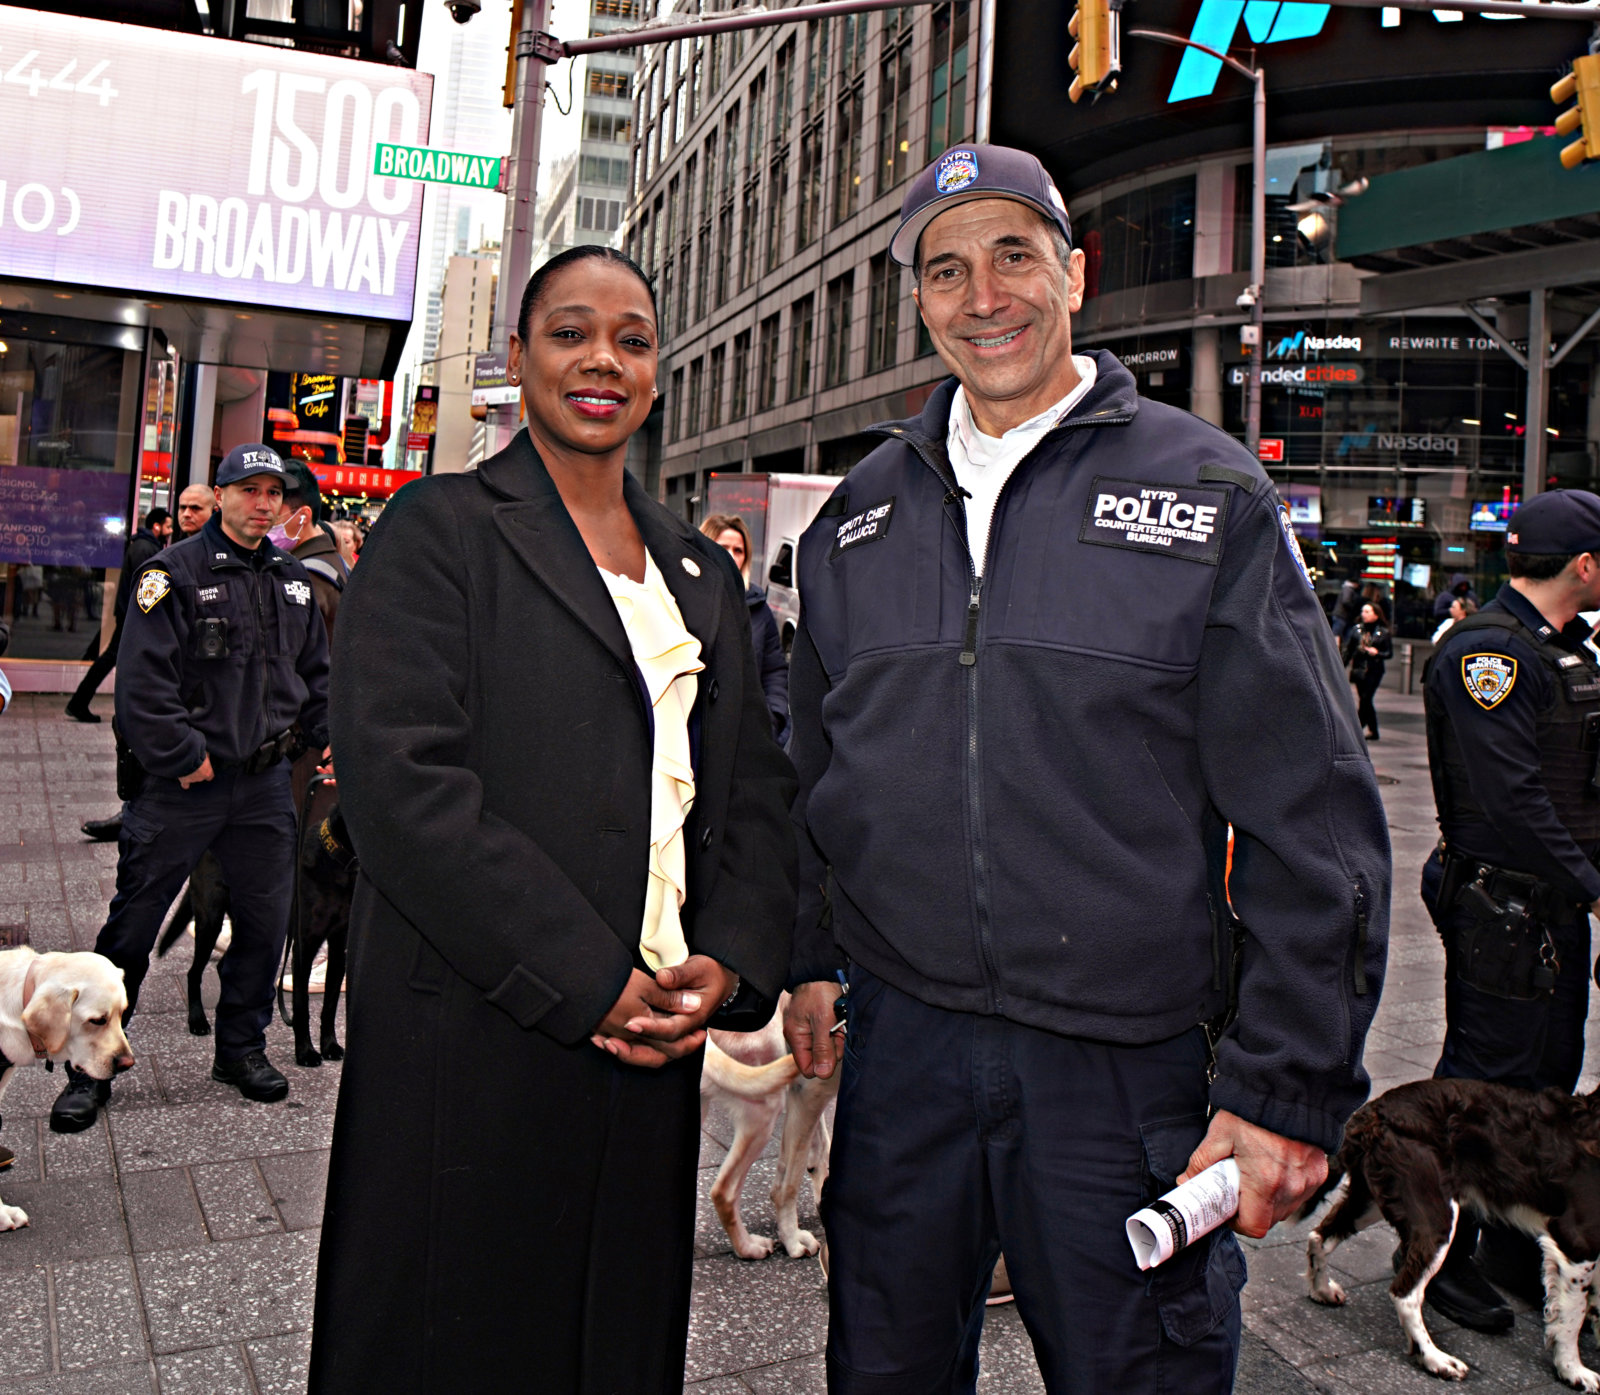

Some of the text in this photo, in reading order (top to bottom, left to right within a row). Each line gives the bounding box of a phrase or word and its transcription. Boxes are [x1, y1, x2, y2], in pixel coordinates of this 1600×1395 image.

[241, 68, 420, 215] 1500
[380, 145, 495, 186] BROADWAY
[941, 152, 971, 169] NYPD
[153, 189, 410, 297] BROADWAY
[1304, 334, 1362, 352] Nasdaq
[1389, 337, 1460, 350] REWRITE
[1233, 365, 1357, 384] bndedcities
[305, 400, 329, 418] Cafe
[1376, 432, 1459, 457] Nasdaq
[335, 471, 392, 487] DINER
[1140, 488, 1178, 502] NYPD
[836, 504, 891, 538] DEPUTY CHIEF
[1093, 493, 1218, 534] POLICE
[839, 521, 878, 548] GALLUCCI
[1094, 518, 1207, 543] COUNTERTERRORISM
[1126, 532, 1173, 547] BUREAU
[1476, 656, 1503, 665] POLICE
